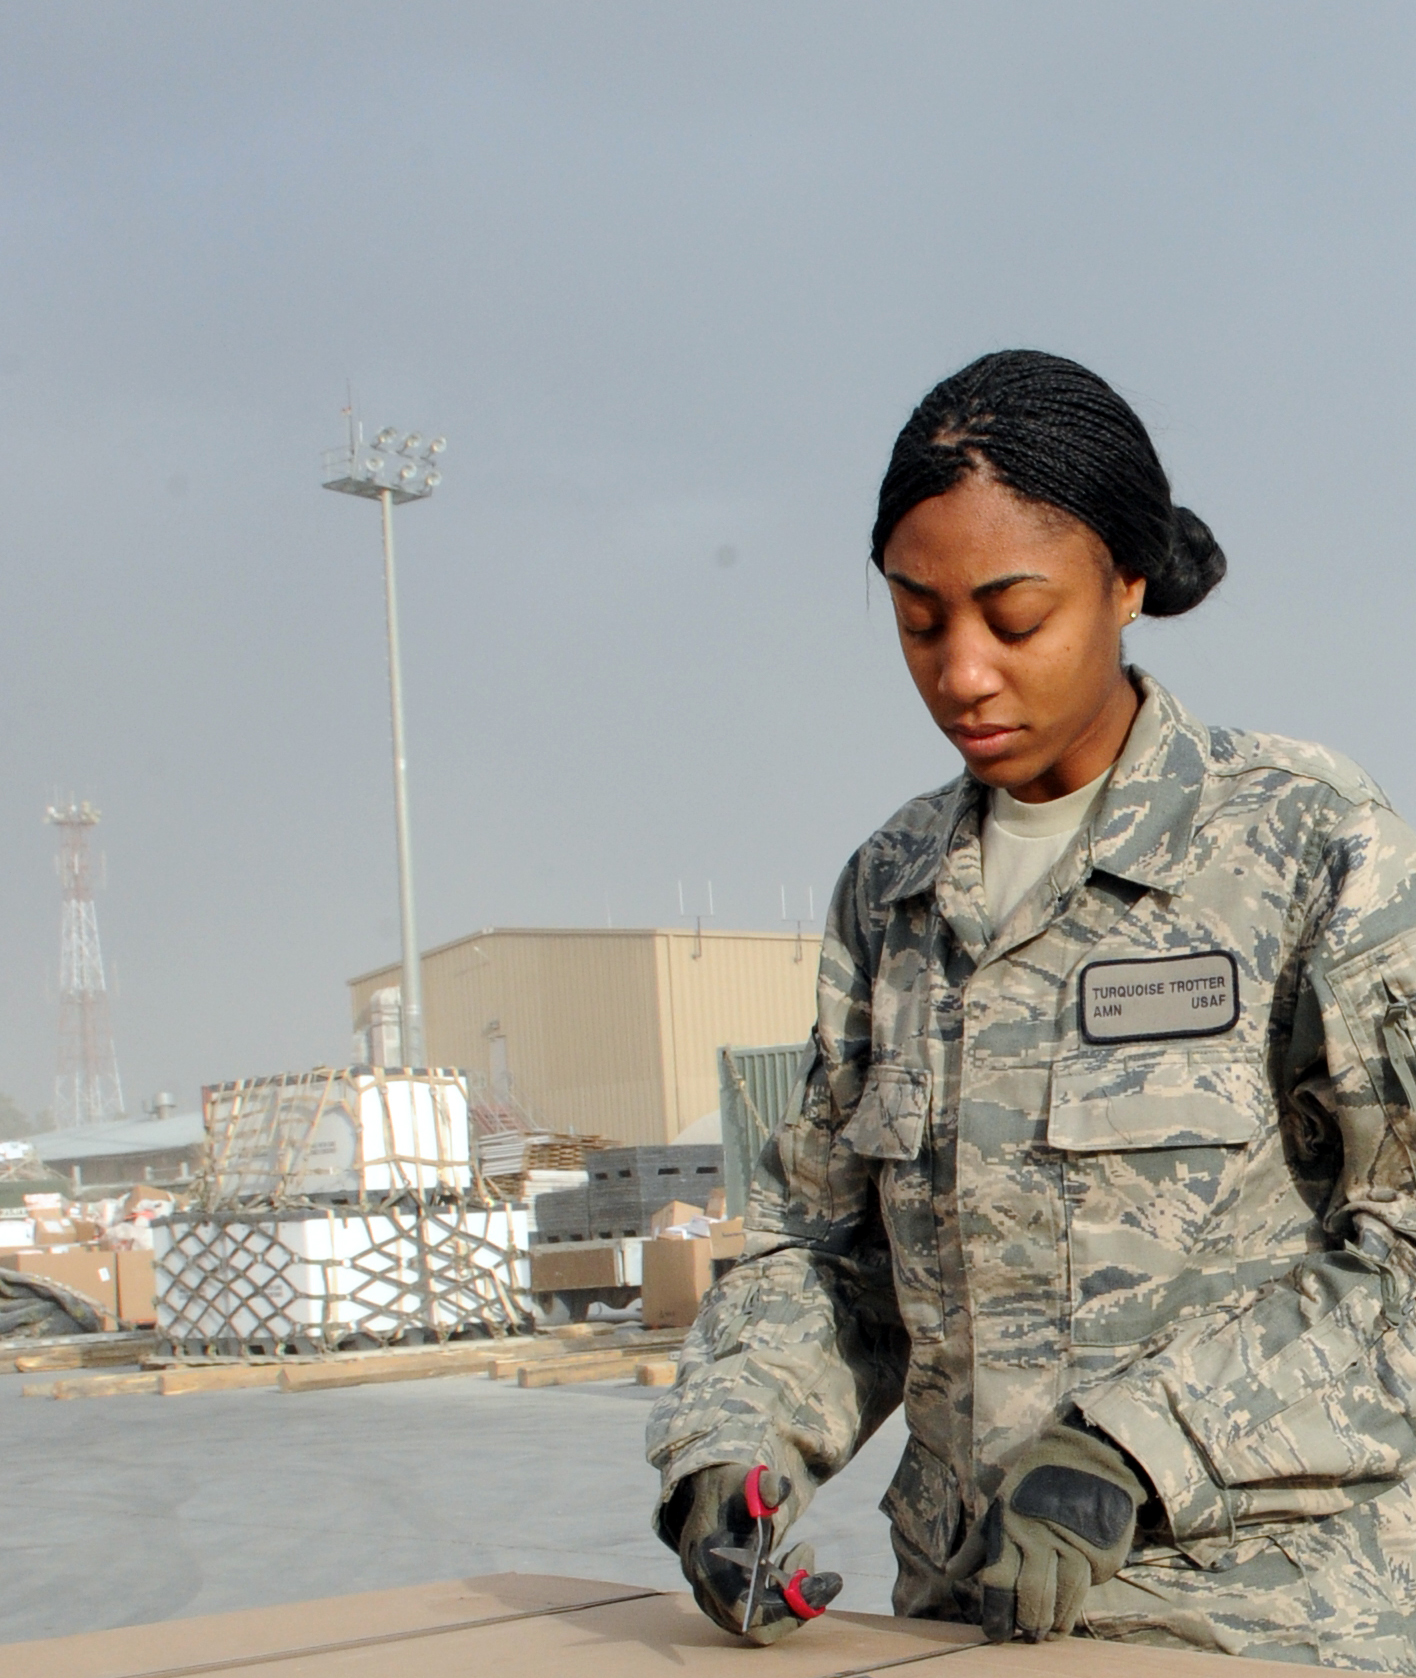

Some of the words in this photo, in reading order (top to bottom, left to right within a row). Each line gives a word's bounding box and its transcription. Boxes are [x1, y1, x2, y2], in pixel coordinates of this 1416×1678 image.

[1092, 983, 1165, 1001] TURQUOISE
[1169, 976, 1226, 993] TROTTER
[1093, 1004, 1122, 1018] AMN
[1191, 994, 1226, 1009] USAF
